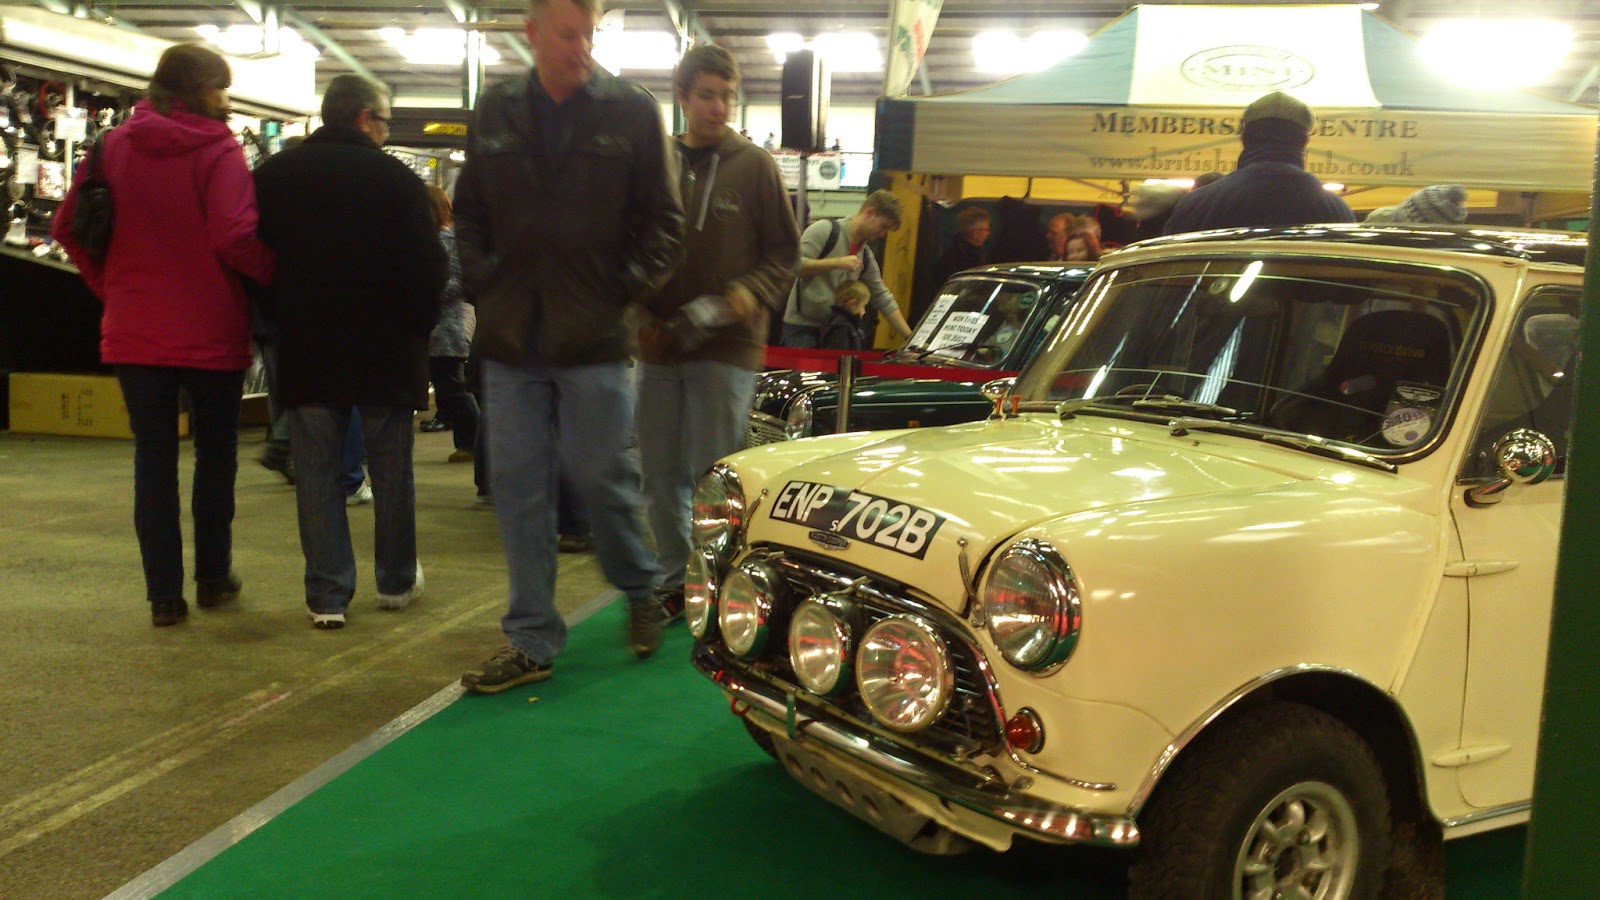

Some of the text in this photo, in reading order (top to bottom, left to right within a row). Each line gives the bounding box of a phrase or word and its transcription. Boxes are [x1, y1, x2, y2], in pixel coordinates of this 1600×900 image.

[1091, 112, 1419, 139] MEMBERS ENTRE
[957, 325, 978, 335] TODAY
[773, 482, 936, 554] ENP 702B
